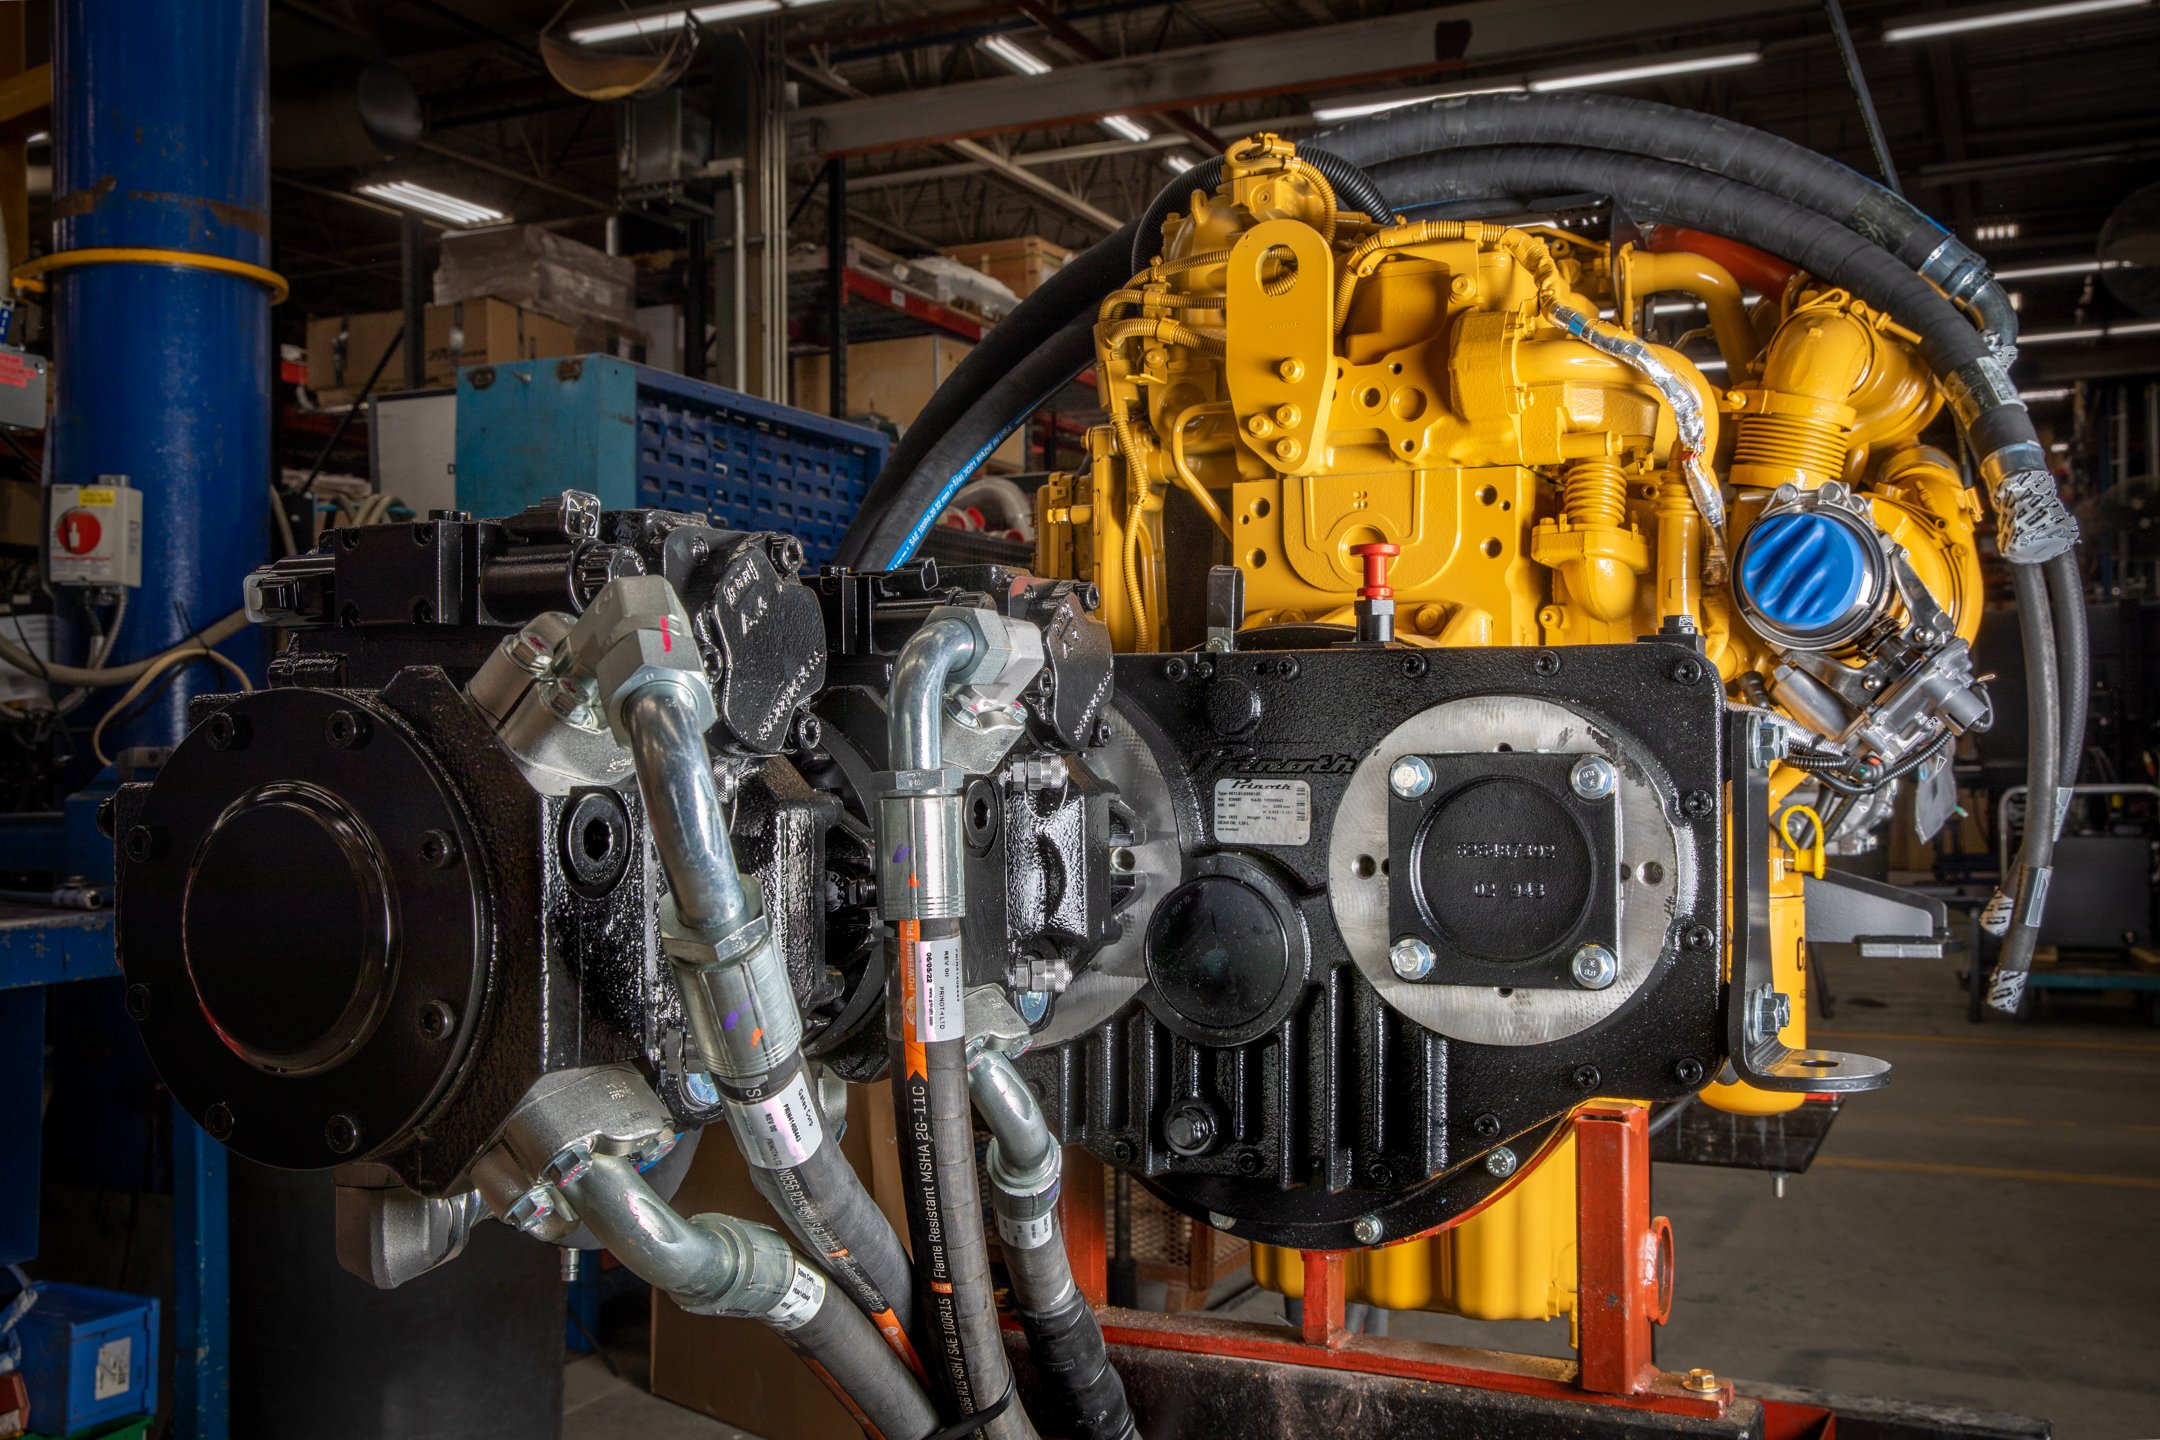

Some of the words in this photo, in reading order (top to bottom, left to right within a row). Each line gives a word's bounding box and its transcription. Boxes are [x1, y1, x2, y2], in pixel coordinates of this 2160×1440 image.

[908, 530, 919, 547] SAE
[976, 444, 994, 463] MADE
[1230, 778, 1291, 790] Prinoth
[1474, 881, 1496, 897] 02
[907, 939, 915, 991] POWERING
[798, 1088, 808, 1111] Gates
[912, 1086, 929, 1142] 2G-11C
[917, 1144, 933, 1183] MSHA
[776, 1168, 800, 1191] N856
[788, 1190, 808, 1206] R15
[924, 1186, 942, 1243] Resistant
[933, 1244, 946, 1280] Flame
[939, 1298, 957, 1338] 100R15
[946, 1336, 959, 1356] SAE
[952, 1361, 965, 1379] 4SH
[955, 1380, 969, 1399] R15
